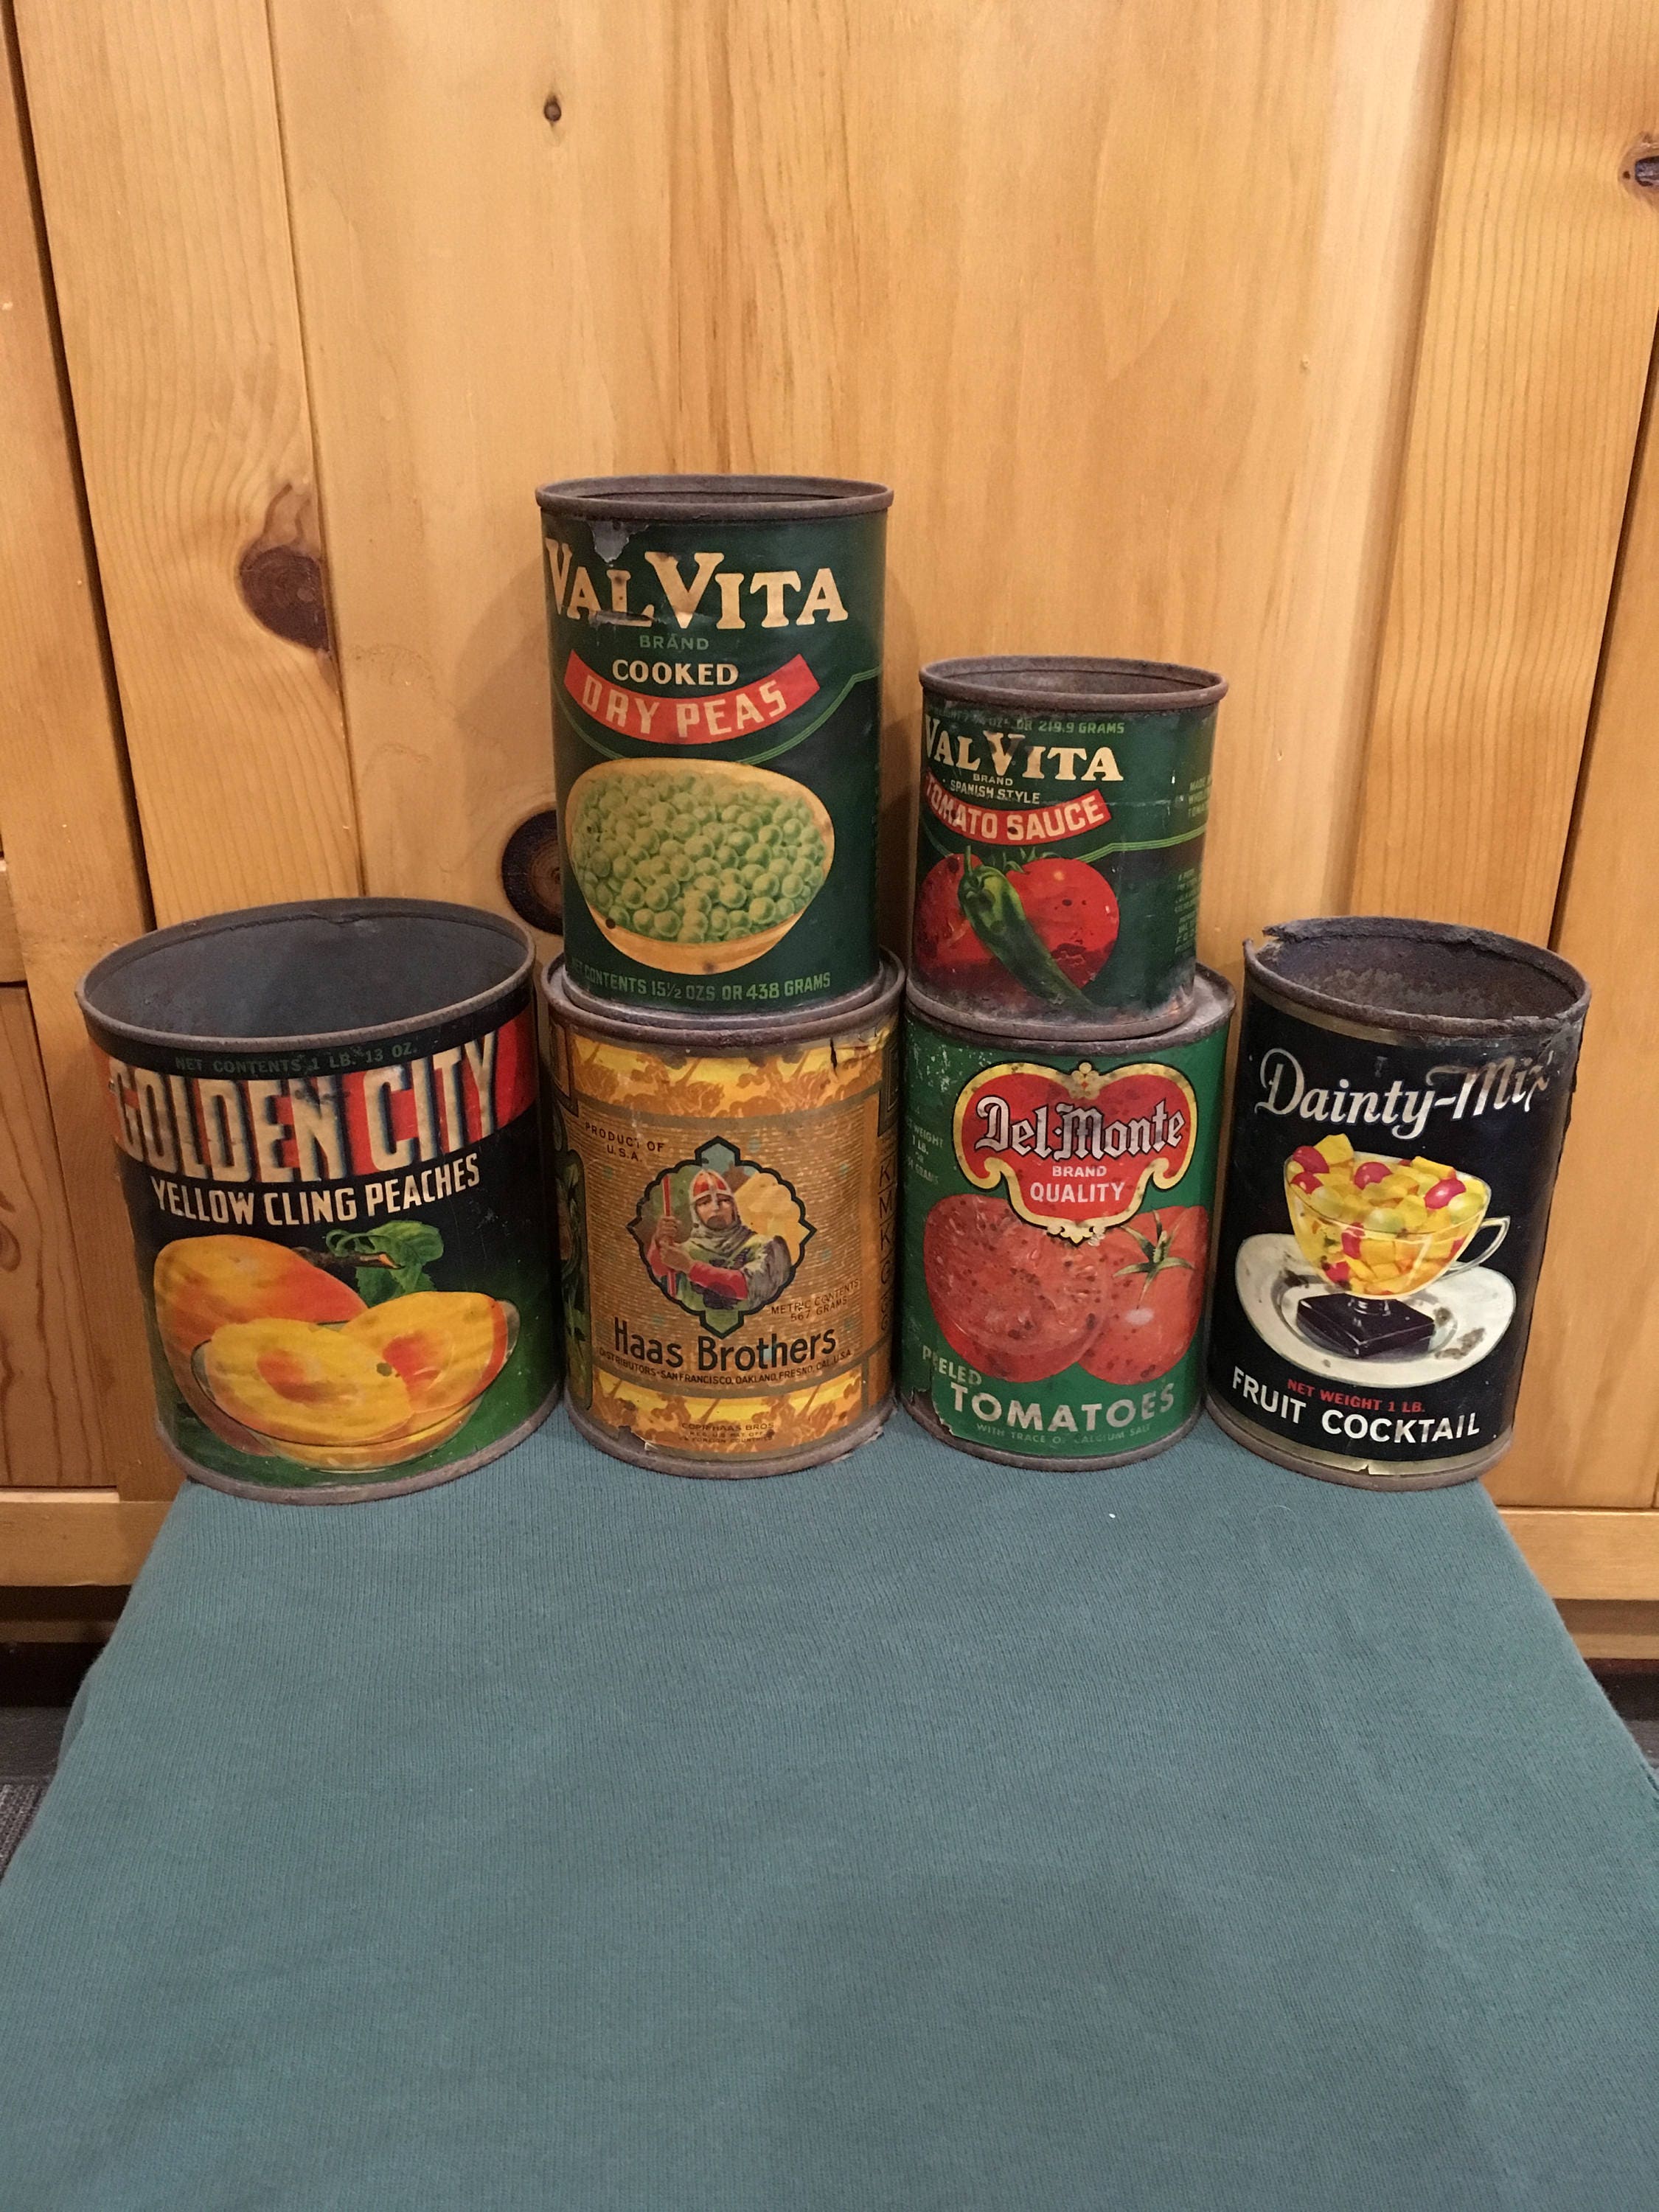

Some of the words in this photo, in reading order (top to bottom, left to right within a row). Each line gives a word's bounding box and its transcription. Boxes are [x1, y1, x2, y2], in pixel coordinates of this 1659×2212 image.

[639, 633, 709, 650] BRAND
[612, 659, 739, 686] COOKED
[581, 675, 660, 734] DRY
[676, 679, 787, 737] PEAS
[1037, 720, 1075, 734] 219.9
[1078, 722, 1125, 734] GRAMS
[950, 779, 994, 799] SPANISH
[996, 788, 1041, 804] STYLE
[973, 773, 1013, 786] BRAND
[926, 774, 998, 839] TOMATO
[1006, 794, 1105, 841] SAUCE
[584, 964, 647, 994] CONTENTS
[721, 984, 743, 1001] OR
[745, 982, 780, 1000] 438
[784, 972, 831, 997] GRAMS
[175, 1057, 204, 1071] NET
[212, 1058, 303, 1074] CONTENTS
[365, 1048, 384, 1063] 13
[108, 1057, 348, 1183] GOLDEN
[362, 1032, 498, 1172] CITY
[585, 1121, 640, 1149] PRODUCT
[646, 1141, 665, 1152] OF
[914, 1124, 944, 1149] WEIGHT
[1051, 1165, 1107, 1178] BRAND
[150, 1175, 254, 1225] YELLOW
[264, 1186, 356, 1226] CLING
[366, 1152, 481, 1217] PEACHES
[1030, 1181, 1126, 1203] QUALITY
[771, 1299, 811, 1315] METRIC
[814, 1278, 860, 1307] CONTENTS
[790, 1310, 811, 1322] 567
[815, 1295, 848, 1315] GRAMS
[613, 1316, 684, 1368] Haas
[698, 1329, 837, 1372] Brothers
[950, 1381, 1175, 1432] TOMATOES
[1232, 1366, 1307, 1425] FRUIT
[1321, 1410, 1481, 1444] COCKTAIL
[1287, 1378, 1317, 1398] NET
[1319, 1389, 1383, 1411] WEIGHT
[1387, 1402, 1395, 1413] 1
[745, 1422, 774, 1431] BROS
[976, 1422, 1005, 1436] WITH
[1010, 1431, 1046, 1444] TRACE
[1130, 1424, 1151, 1436] SALT
